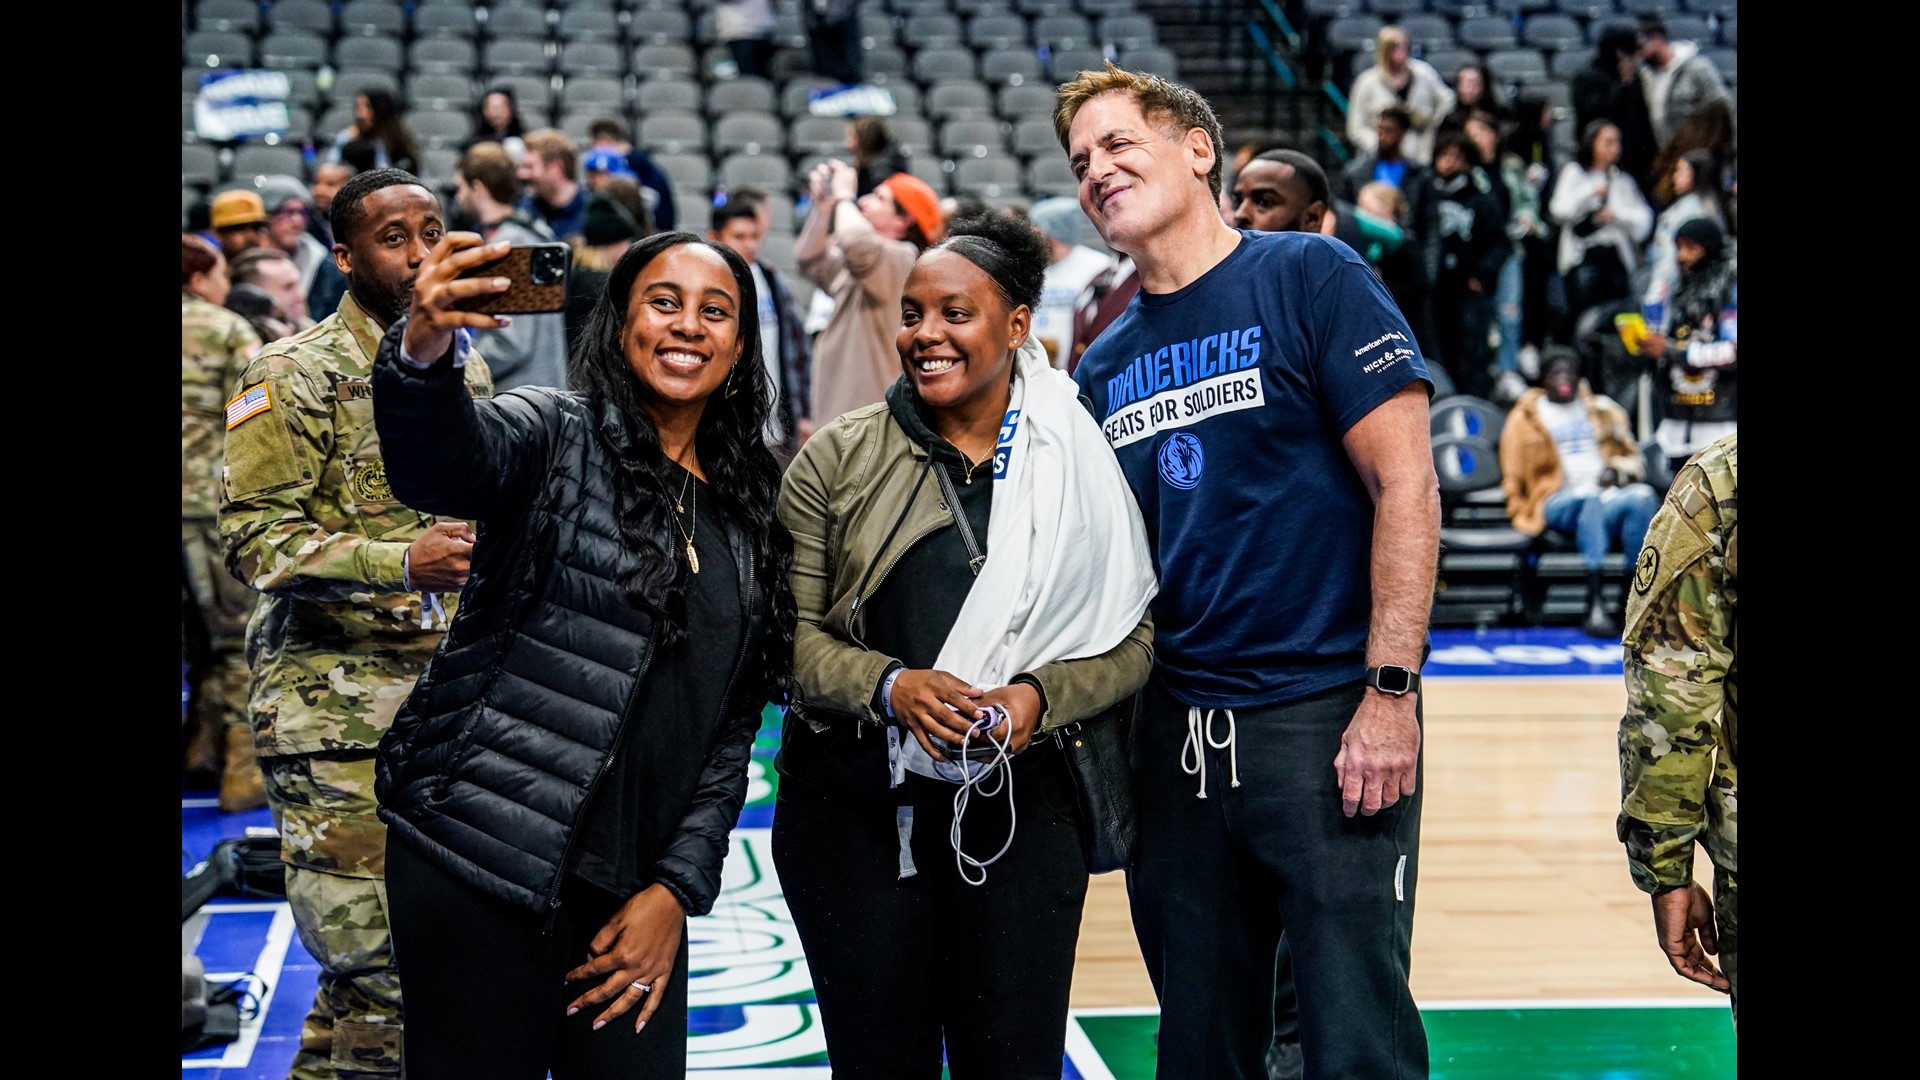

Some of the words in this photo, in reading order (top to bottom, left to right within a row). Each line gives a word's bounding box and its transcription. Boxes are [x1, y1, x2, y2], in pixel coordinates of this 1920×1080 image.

[1354, 340, 1382, 357] American
[1363, 357, 1386, 374] NICK
[1106, 325, 1261, 417] MAVERICKS
[1104, 409, 1145, 444] SEATS
[1150, 398, 1179, 428] FOR
[1184, 377, 1258, 417] SOLDIERS
